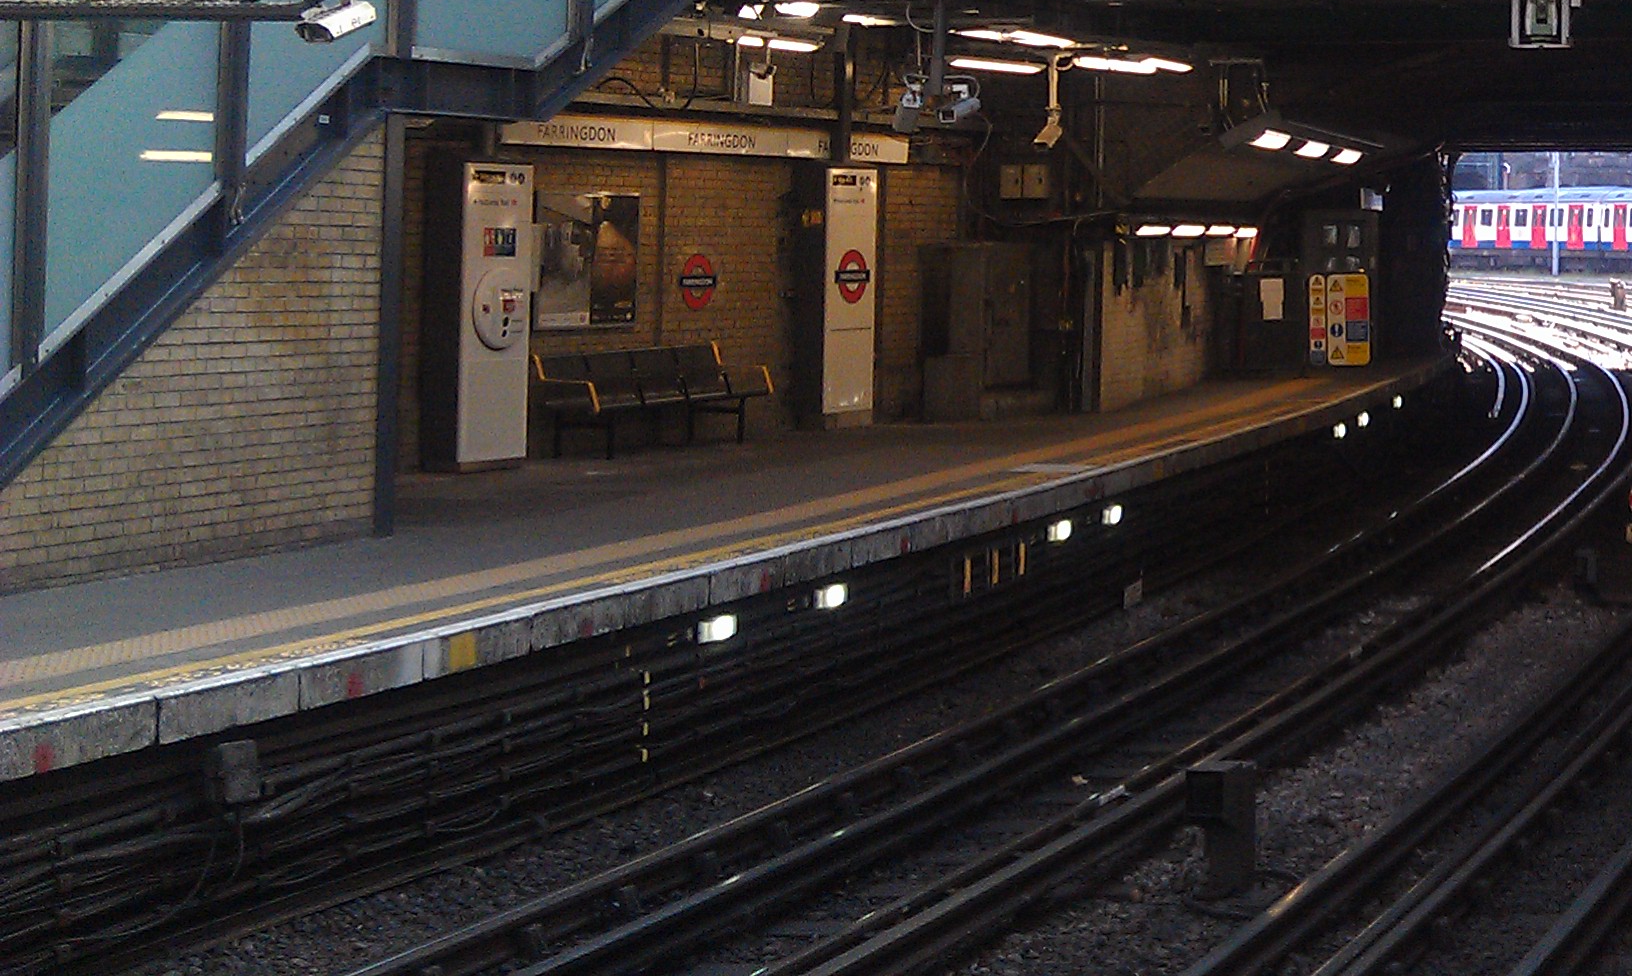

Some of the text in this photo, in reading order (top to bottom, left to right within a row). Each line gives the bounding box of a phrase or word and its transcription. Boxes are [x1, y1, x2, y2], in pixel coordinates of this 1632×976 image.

[537, 124, 616, 142] FARRINGDON
[687, 131, 756, 149] FARRINGDON
[818, 140, 879, 156] FAGDON
